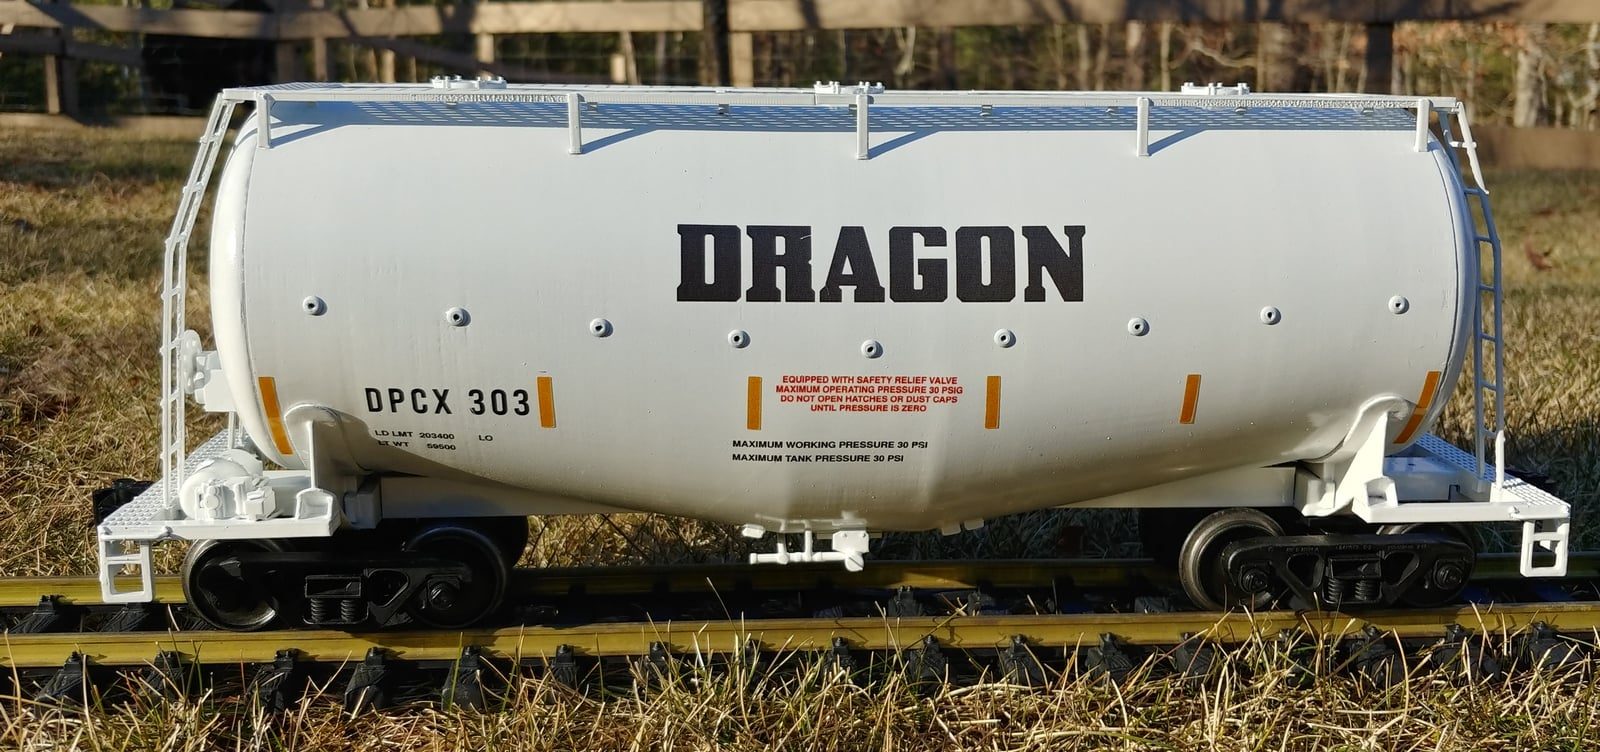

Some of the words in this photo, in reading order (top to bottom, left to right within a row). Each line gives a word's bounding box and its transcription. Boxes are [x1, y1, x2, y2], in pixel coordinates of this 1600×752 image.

[677, 224, 1086, 302] DRAGON
[782, 375, 829, 384] EQUIPPED
[831, 376, 856, 384] WITH
[856, 376, 892, 384] SAFETY
[895, 376, 927, 384] RELIEF
[929, 376, 958, 385] VALVE
[775, 386, 820, 394] MAXIMUM
[822, 386, 875, 394] OPERATING
[877, 386, 926, 394] PRESSURE
[928, 386, 940, 394] 30
[941, 386, 963, 394] PSIG
[364, 387, 453, 414] DPCX
[468, 389, 530, 416] 303
[780, 395, 795, 403] DO
[796, 395, 815, 403] NOT
[817, 395, 843, 403] OPEN
[845, 395, 888, 403] HATCHES
[890, 395, 904, 403] OR
[906, 395, 931, 403] DUST
[933, 396, 958, 404] CAPS
[810, 404, 837, 412] UNTIL
[839, 404, 889, 412] PRESSURE
[891, 404, 900, 412] IS
[901, 405, 927, 413] ZERO
[419, 432, 455, 440] 203400
[478, 434, 494, 442] LO
[426, 443, 456, 451] 59500
[732, 440, 783, 449] MAXIMUM
[786, 441, 836, 449] WORKING
[838, 441, 895, 449] PRESSURE
[897, 441, 909, 449] 30
[911, 441, 928, 449] PSI
[732, 454, 783, 462] MAXIMUM
[785, 454, 812, 462] TANK
[815, 454, 871, 462] PRESSURE
[873, 454, 885, 462] 30
[887, 454, 904, 462] PSI
